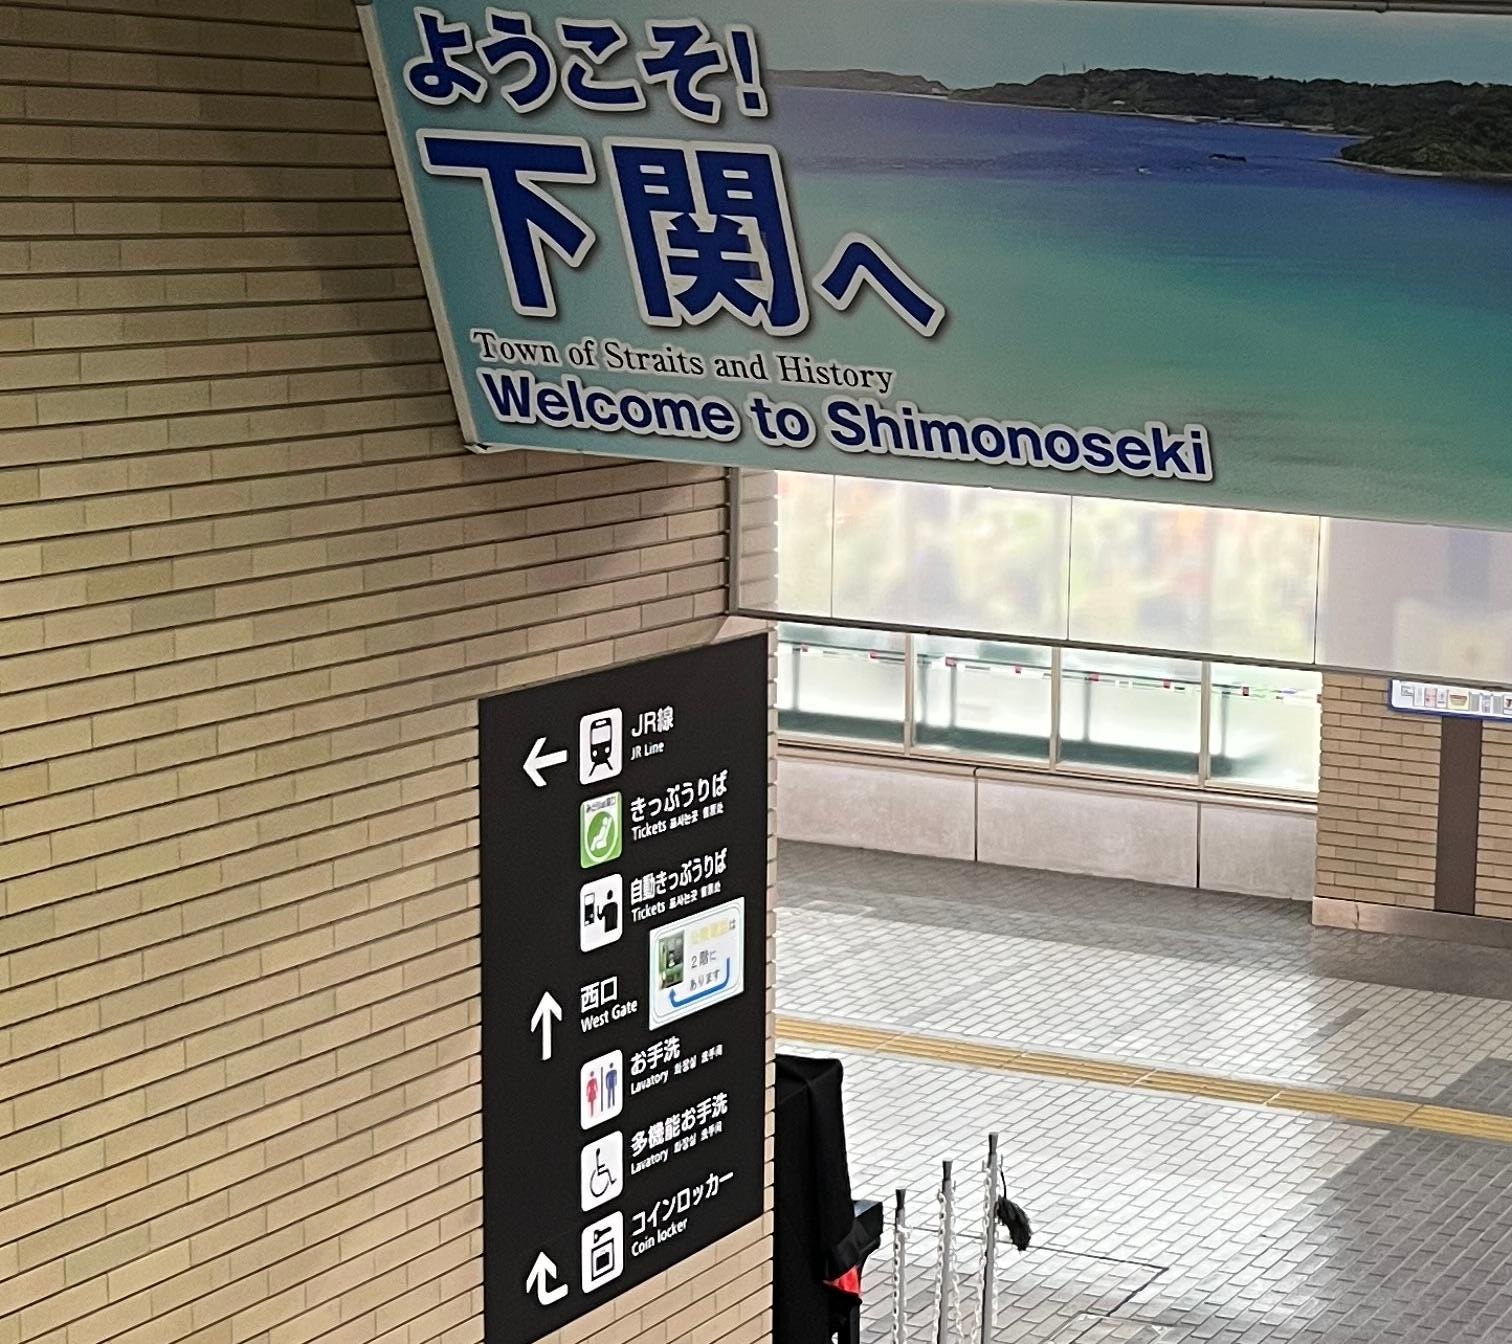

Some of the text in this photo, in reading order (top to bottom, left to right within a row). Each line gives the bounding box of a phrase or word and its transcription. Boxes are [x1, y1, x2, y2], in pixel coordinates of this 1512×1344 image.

[403, 7, 768, 123] ようこそ!
[417, 129, 945, 336] 下関へ
[472, 329, 893, 394] Town of Straits and History
[480, 370, 1207, 475] Welcome to Shimonoseki
[631, 705, 674, 737] JR線
[630, 742, 665, 761] JR Line
[631, 820, 667, 841] Tickets
[631, 901, 666, 923] Tickets
[580, 975, 618, 1014] 西口
[580, 1000, 638, 1033] West Gate
[630, 1036, 681, 1076] お手洗
[631, 1070, 669, 1095] Lavatory
[630, 1092, 728, 1158] 多機能お手洗
[631, 1149, 669, 1175] Lavatory
[632, 1171, 734, 1237] コインロッカー
[631, 1217, 688, 1257] Coin locker
